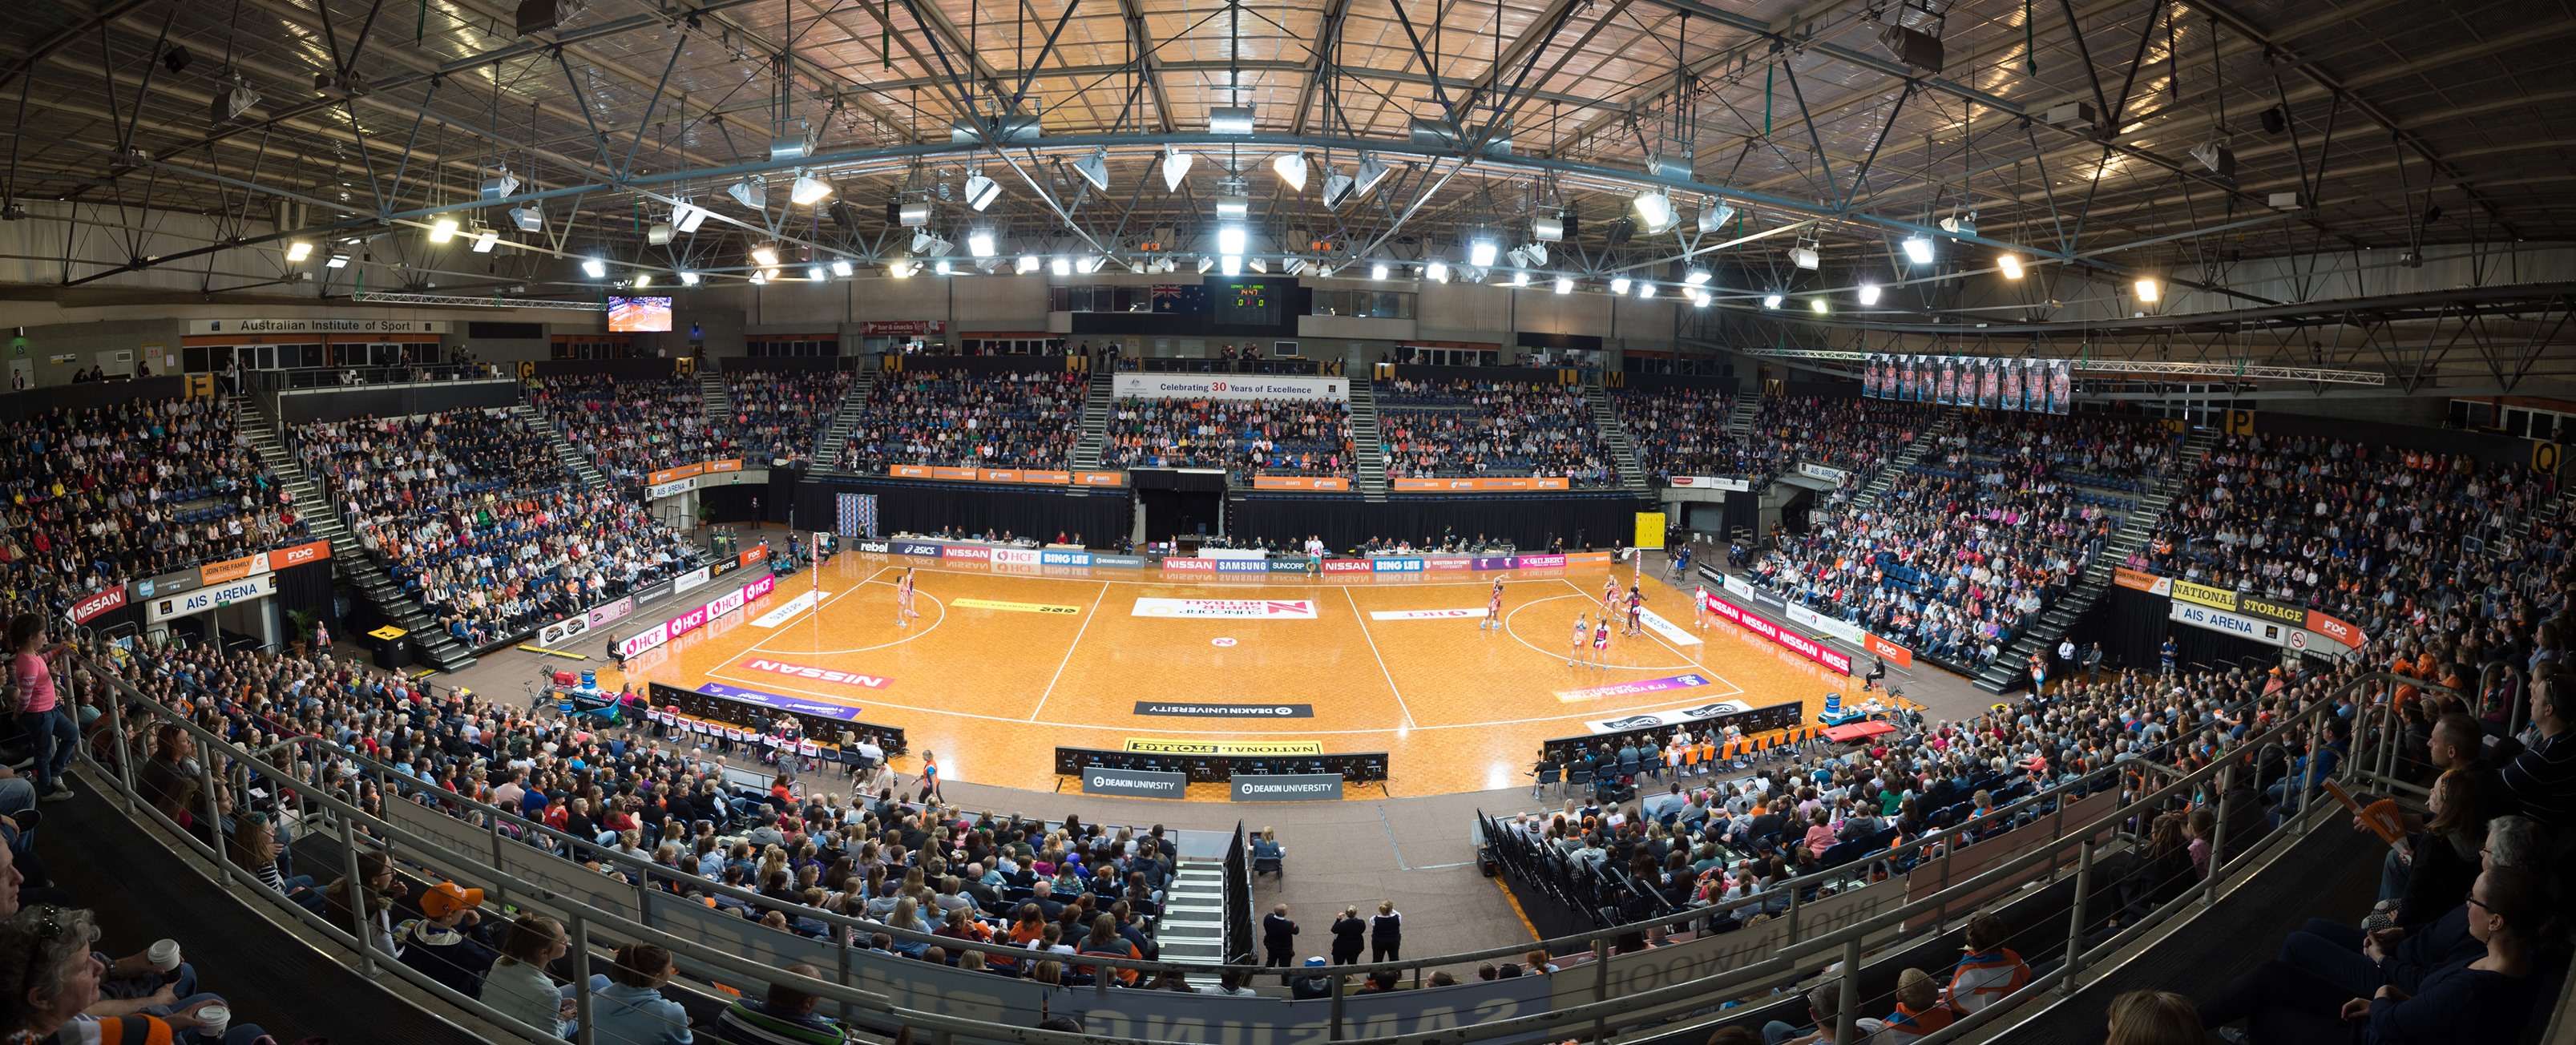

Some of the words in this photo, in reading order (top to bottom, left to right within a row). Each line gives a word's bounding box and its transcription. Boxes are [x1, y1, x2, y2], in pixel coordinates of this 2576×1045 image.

[240, 320, 306, 331] Australian
[313, 321, 360, 330] Institute
[365, 321, 376, 330] of
[381, 321, 410, 332] Sport
[1324, 361, 1337, 377] K
[1380, 365, 1391, 381] L
[1608, 371, 1622, 388] M
[1161, 383, 1209, 393] Celebrating
[1212, 381, 1226, 392] 30
[1230, 385, 1252, 393] Years
[1255, 385, 1263, 393] of
[1266, 385, 1311, 394] Excellence
[2233, 409, 2250, 436] P
[2536, 442, 2557, 474] Q
[1811, 466, 1819, 474] AIS
[657, 487, 665, 495] AIS
[668, 484, 685, 494] ARENA
[288, 548, 313, 559] FDC
[861, 542, 888, 553] rebel
[946, 548, 988, 558] NISSAN
[748, 550, 761, 559] FDC
[1011, 552, 1035, 561] HCF
[1044, 553, 1071, 564] BING
[1072, 555, 1089, 564] LEE
[1530, 556, 1565, 564] GILBERT
[205, 567, 218, 575] JOIN
[219, 564, 230, 572] THE
[231, 560, 250, 571] FAMILY
[1167, 561, 1212, 569] NISSAN
[1219, 562, 1266, 570] SAMSUNG
[1376, 561, 1403, 571] BING
[1403, 561, 1420, 570] LEE
[2116, 569, 2126, 577] JOIN
[2136, 574, 2154, 583] FAMILY
[654, 587, 671, 598] UNIVERSITY
[752, 578, 771, 595] HCF
[187, 595, 207, 610] AIS
[215, 583, 257, 603] ARENA
[2174, 583, 2236, 607] NATIONAL
[76, 591, 120, 620] NISSAN
[722, 594, 739, 611] HCF
[1709, 597, 1738, 619] NISSAN
[1770, 597, 1784, 608] UNIVERSITY
[2243, 599, 2303, 622] STORAGE
[682, 611, 704, 630] HCF
[1742, 614, 1775, 638] NISSAN
[2183, 608, 2203, 622] AIS
[2209, 614, 2252, 634] ARENA
[1824, 620, 1855, 639] Woolworths
[2324, 620, 2347, 635] FDC
[639, 629, 661, 646] HCF
[1779, 631, 1818, 657] NISSAN
[1876, 641, 1897, 656] FDC
[750, 660, 883, 688] NISSAN
[1561, 689, 1614, 700] PLAYTIME
[1616, 685, 1646, 694] YOUR
[1648, 684, 1667, 692] IT'S
[1149, 705, 1228, 713] UNIVERSITY
[1132, 743, 1214, 752] STORAGE
[1105, 779, 1133, 787] DEAKIN
[1282, 784, 1332, 793] UNIVERSITY
